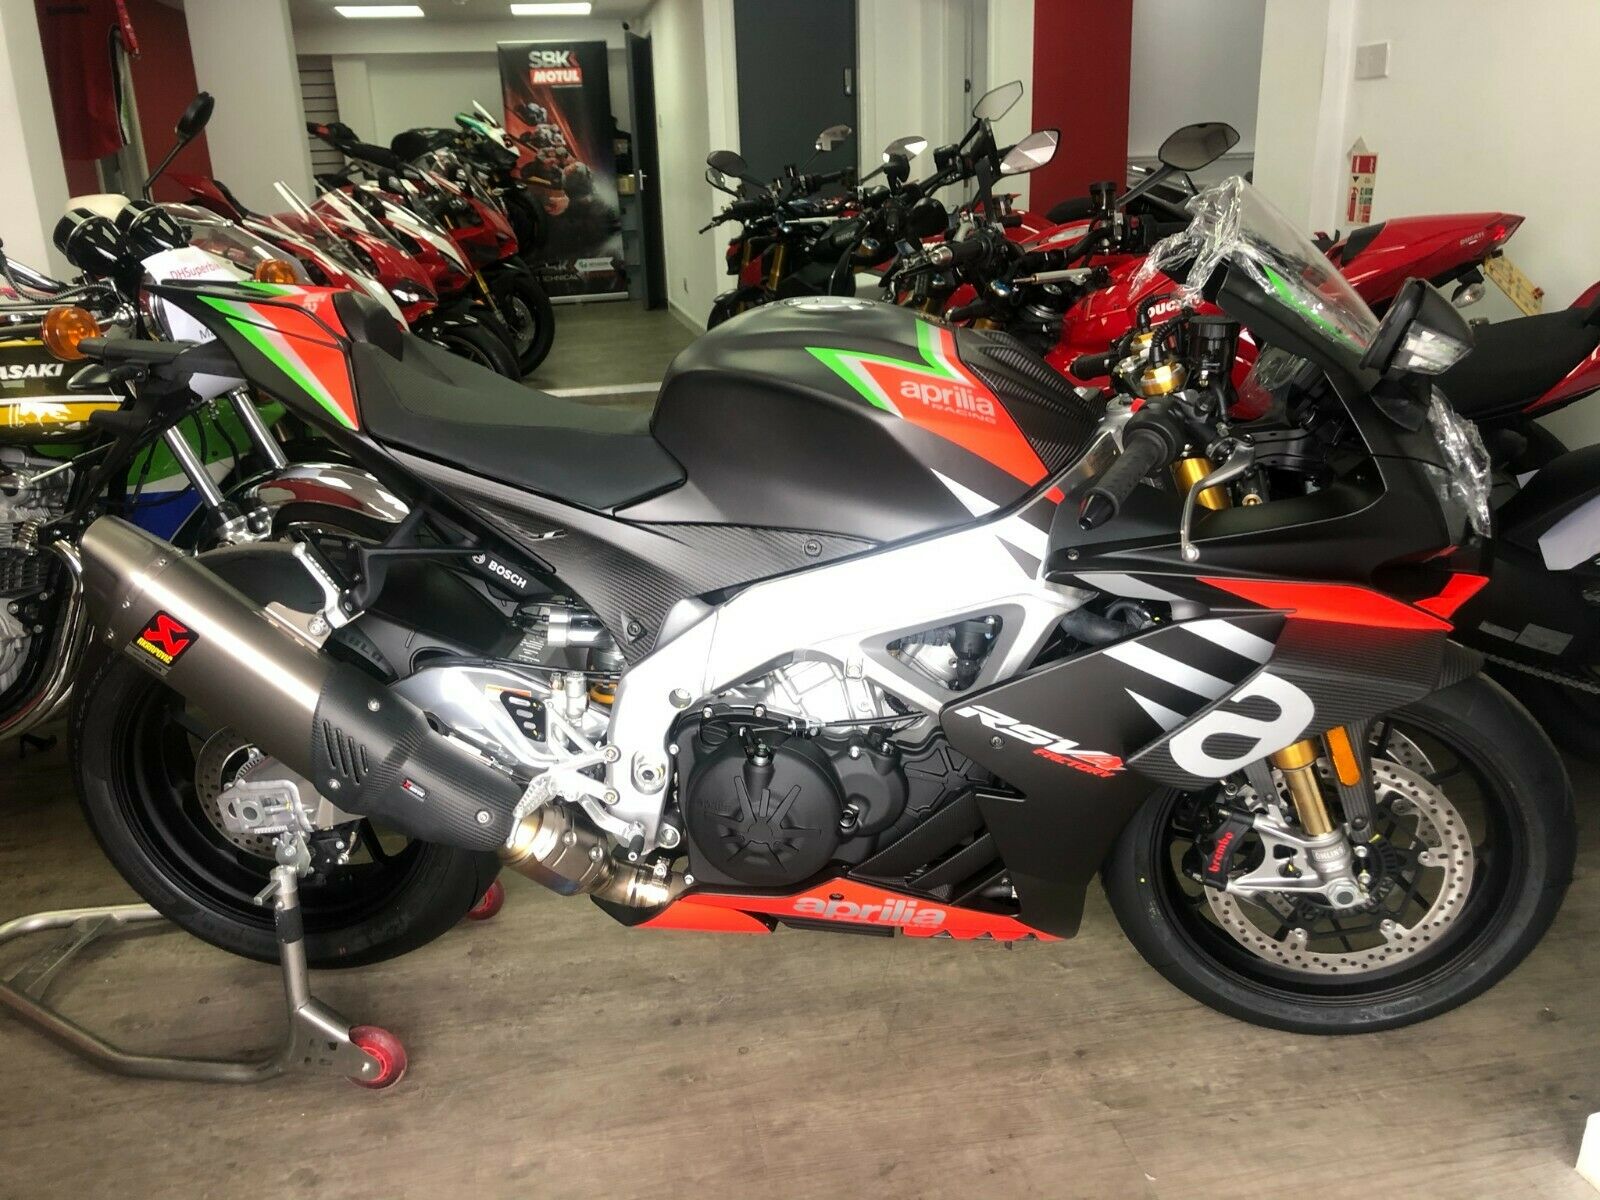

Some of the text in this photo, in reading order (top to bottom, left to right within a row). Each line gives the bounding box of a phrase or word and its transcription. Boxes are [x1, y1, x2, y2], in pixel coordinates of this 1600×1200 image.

[528, 50, 573, 68] SBK
[533, 70, 580, 83] MOTUL
[900, 380, 996, 417] aprilia
[931, 402, 997, 425] RACING
[488, 560, 527, 589] BOSCH
[1208, 831, 1235, 872] brembo
[793, 896, 948, 925] aprilia
